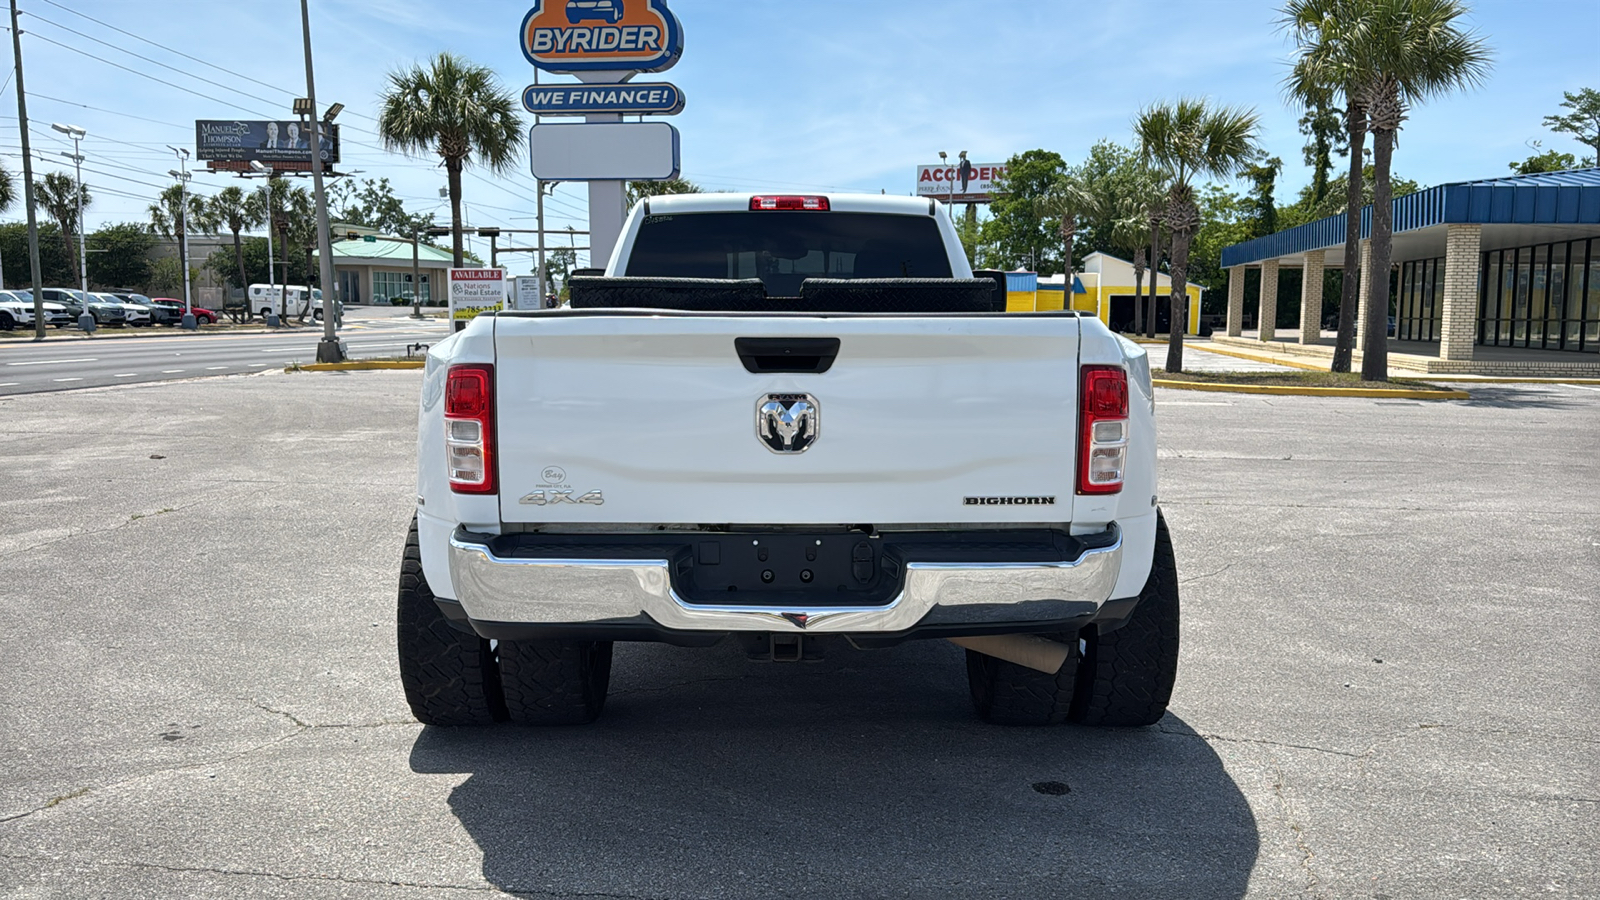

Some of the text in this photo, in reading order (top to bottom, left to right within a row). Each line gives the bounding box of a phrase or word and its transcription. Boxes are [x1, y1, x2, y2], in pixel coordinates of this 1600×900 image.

[532, 26, 659, 51] BYRIDER
[531, 90, 669, 105] WE FINANCE!
[919, 167, 1009, 182] ACCIDEN
[453, 271, 501, 279] AVAILABLE
[963, 496, 1055, 505] BIGHORN
